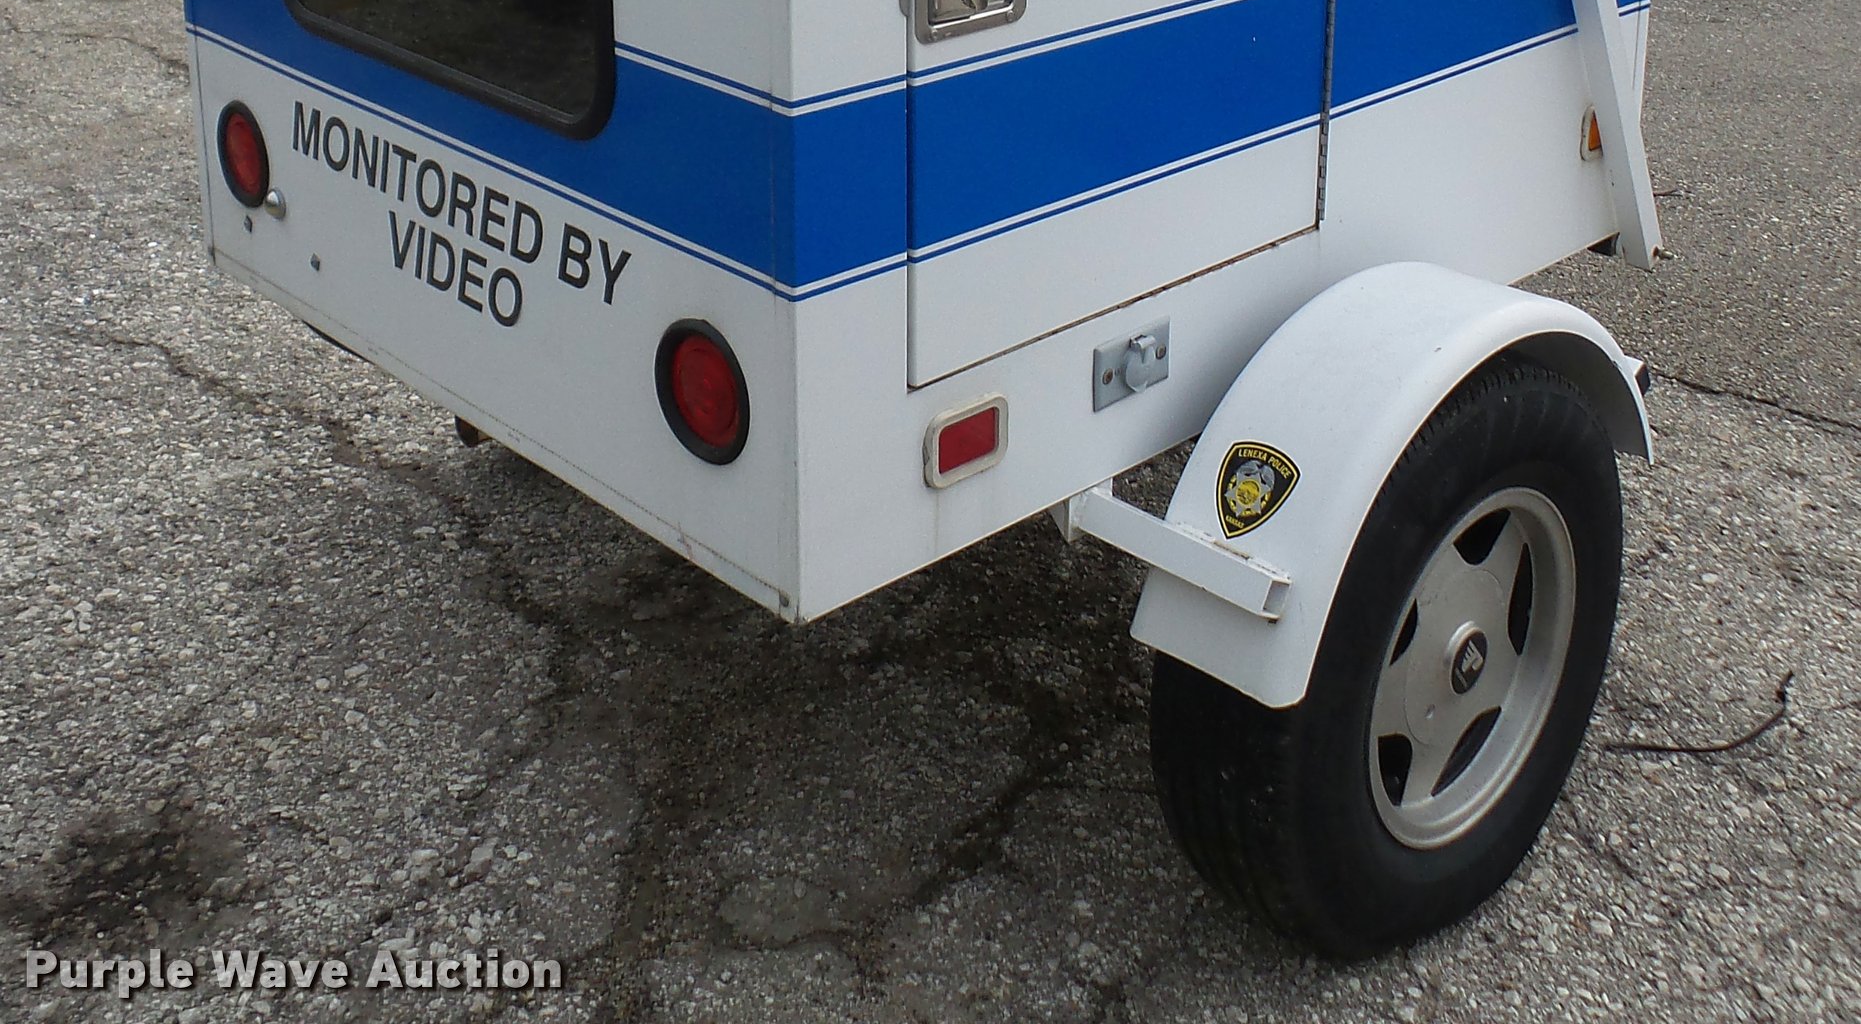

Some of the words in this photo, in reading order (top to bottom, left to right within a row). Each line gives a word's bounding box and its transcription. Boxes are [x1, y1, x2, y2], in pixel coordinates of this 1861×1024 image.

[292, 101, 544, 264] MONITORED
[558, 223, 632, 306] BY
[389, 210, 523, 327] VIDEO
[1239, 449, 1267, 461] LENEXA
[1268, 457, 1291, 479] POLICE
